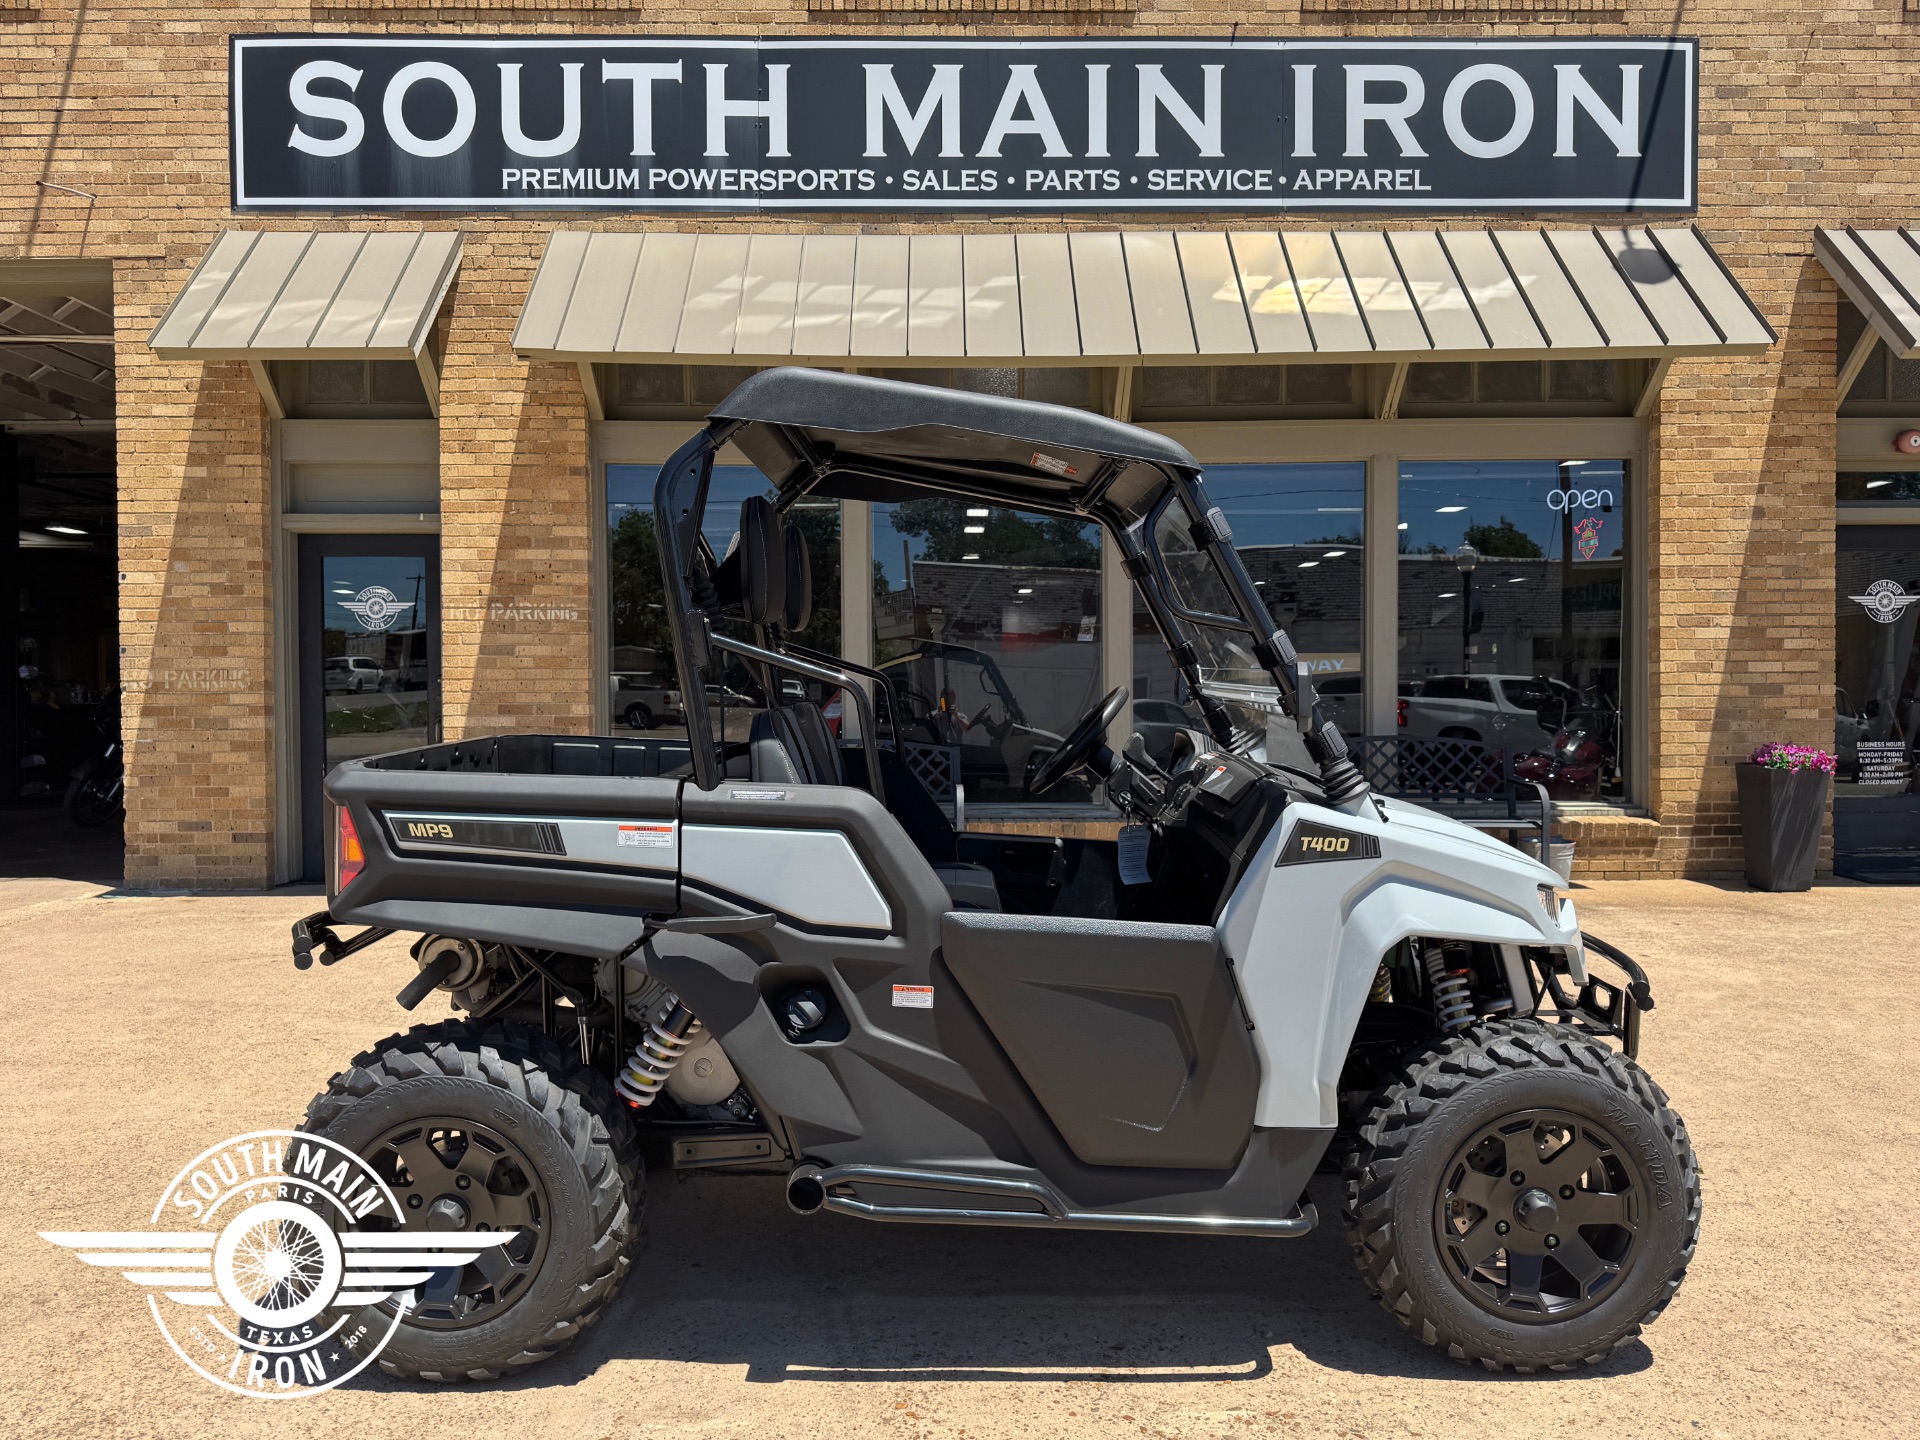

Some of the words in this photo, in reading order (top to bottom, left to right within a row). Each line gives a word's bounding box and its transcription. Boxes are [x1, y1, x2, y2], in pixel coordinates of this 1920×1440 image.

[288, 59, 791, 158] SOUTH
[861, 63, 1225, 158] MAIN
[1290, 63, 1643, 159] IRON
[501, 167, 640, 190] PREMIUM
[648, 168, 876, 194] POWERSPORTS
[902, 169, 998, 192] SALES
[1025, 168, 1121, 191] PARTS
[1147, 168, 1273, 192] SERVICE
[1292, 168, 1432, 191] APPAREL
[1547, 489, 1613, 514] open
[489, 602, 579, 621] PARKING
[163, 669, 251, 689] PARKING
[408, 822, 453, 839] MP9
[1300, 836, 1350, 852] T400
